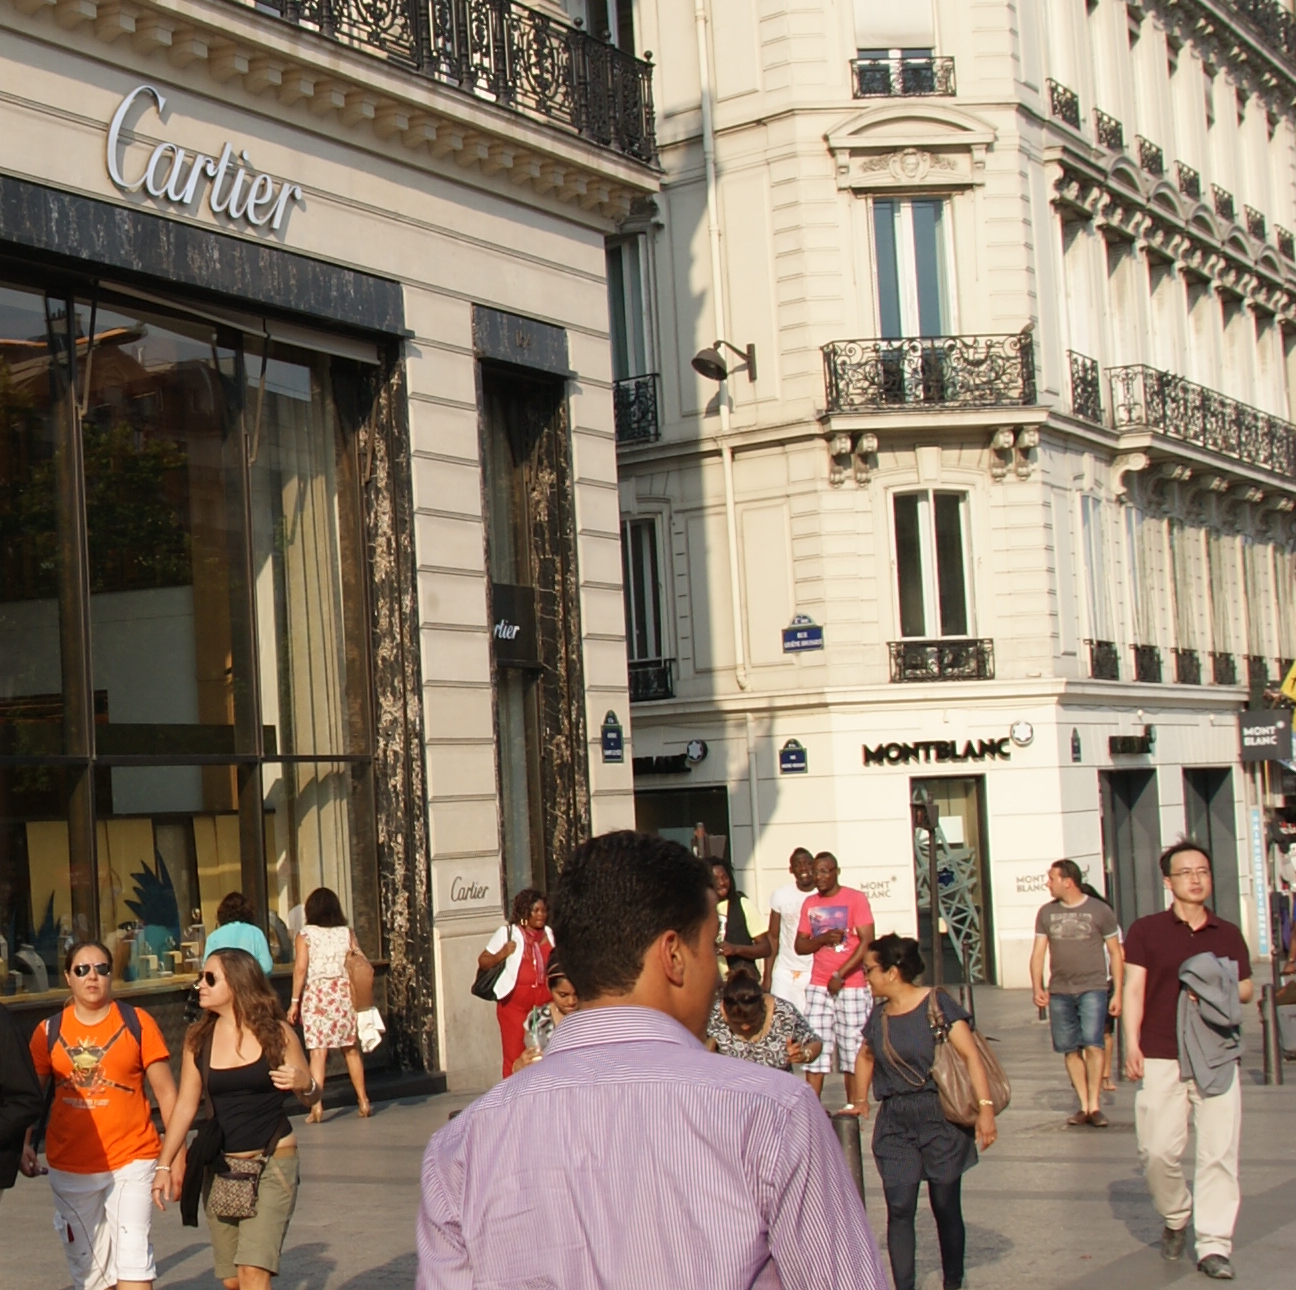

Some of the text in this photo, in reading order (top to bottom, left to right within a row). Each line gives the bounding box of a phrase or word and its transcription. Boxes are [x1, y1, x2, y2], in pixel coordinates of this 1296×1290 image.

[107, 85, 302, 229] Cartier
[494, 618, 520, 639] rtier
[1244, 726, 1276, 736] MONT
[1244, 735, 1277, 746] BLANC
[862, 737, 1011, 765] MONTBLANC
[1016, 874, 1046, 883] MONT
[451, 876, 489, 903] Cartier
[860, 880, 890, 890] MONT
[866, 889, 892, 899] LANC
